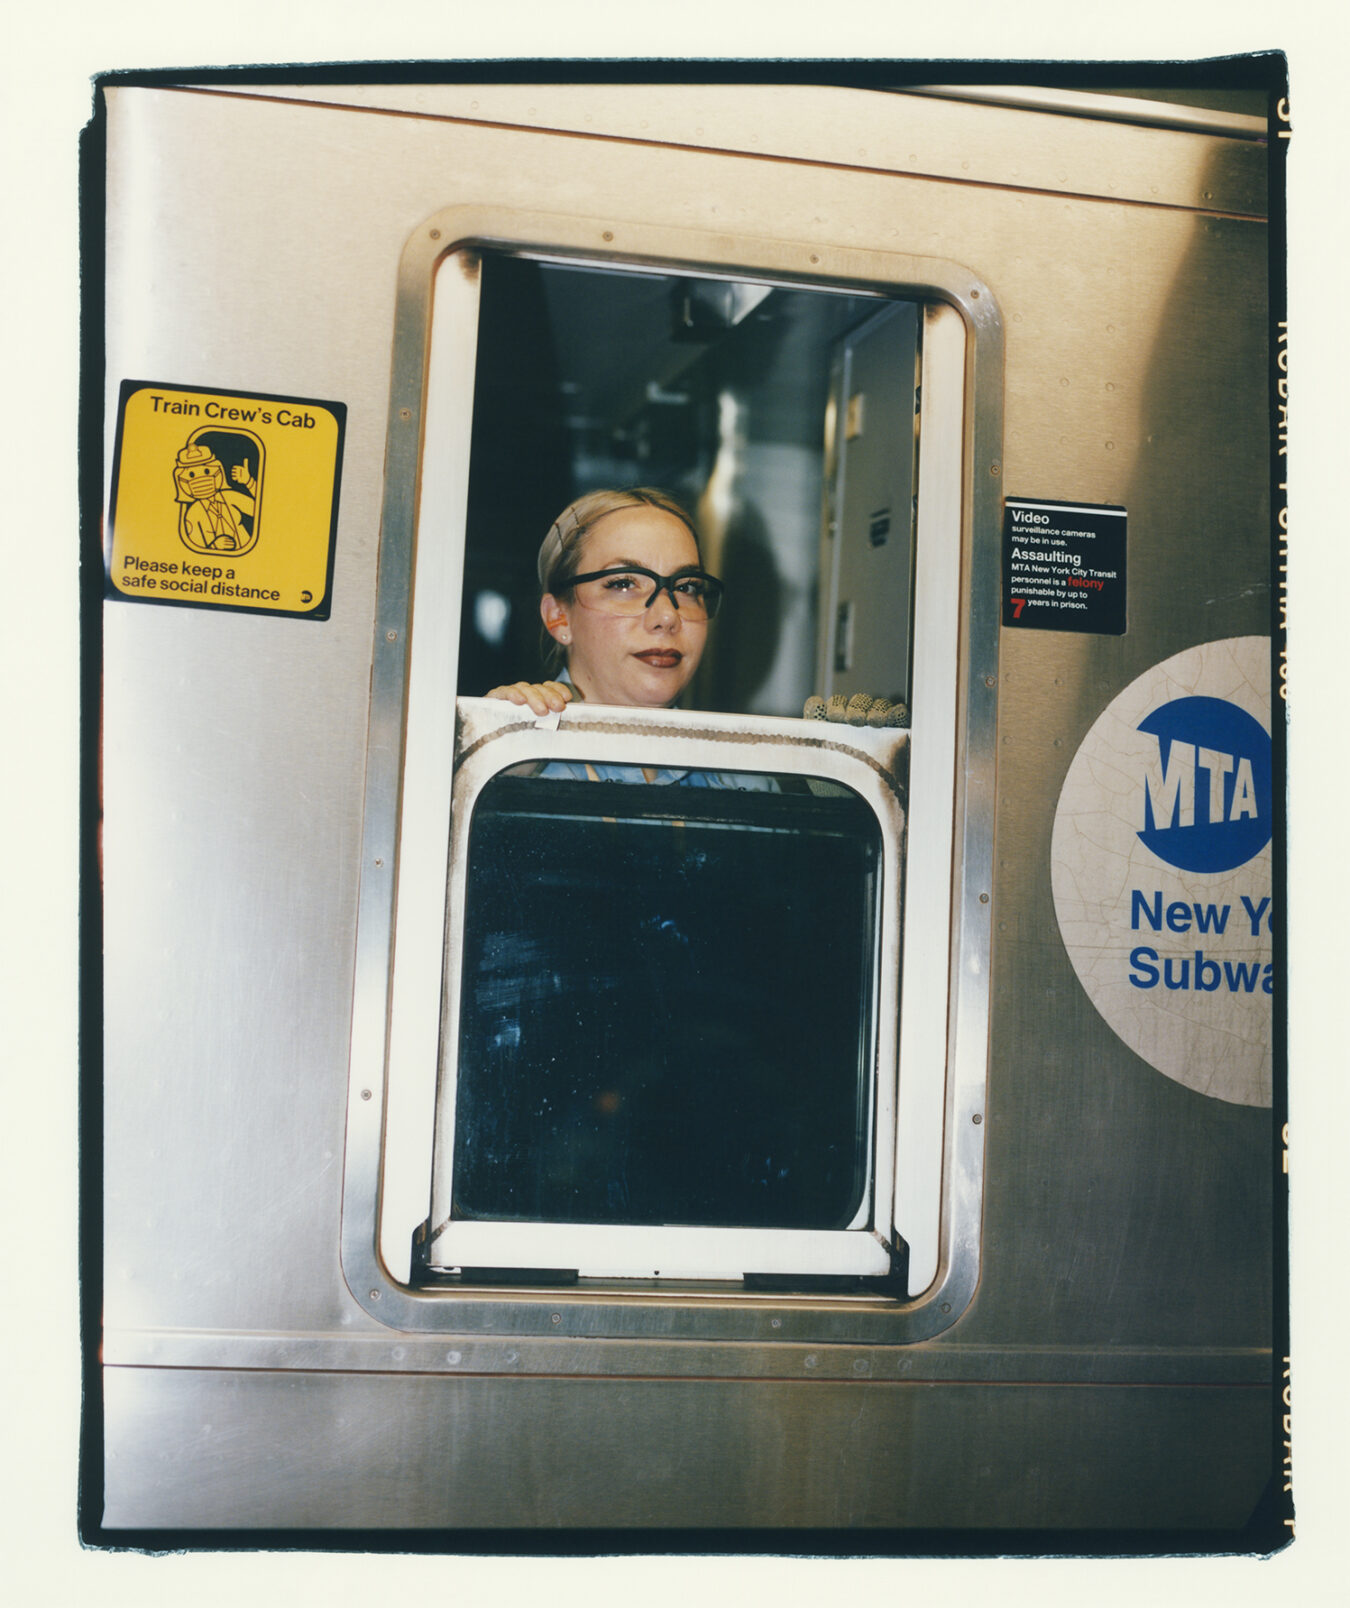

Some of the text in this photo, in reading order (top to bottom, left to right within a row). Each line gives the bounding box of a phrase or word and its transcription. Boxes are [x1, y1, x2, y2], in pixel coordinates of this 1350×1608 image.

[150, 396, 316, 429] Train Crew's Cab
[1011, 510, 1050, 524] Video
[1011, 525, 1096, 539] surveillance cameras
[1011, 535, 1029, 544] may
[1030, 536, 1041, 544] be
[1042, 537, 1049, 545] in
[1011, 547, 1082, 566] Assaulting
[123, 556, 236, 581] Please keep a
[1011, 563, 1117, 579] MTA New York City Transit
[122, 573, 157, 589] safe
[159, 578, 208, 594] social
[210, 583, 281, 601] distance
[1011, 576, 1052, 586] personnel
[1053, 577, 1060, 586] is
[1067, 576, 1104, 591] felony
[1010, 586, 1088, 599] punishable by up to
[1010, 598, 1026, 619] 7
[1027, 599, 1088, 610] years in prison.
[1136, 729, 1258, 833] MTA
[1130, 889, 1273, 937] New Y
